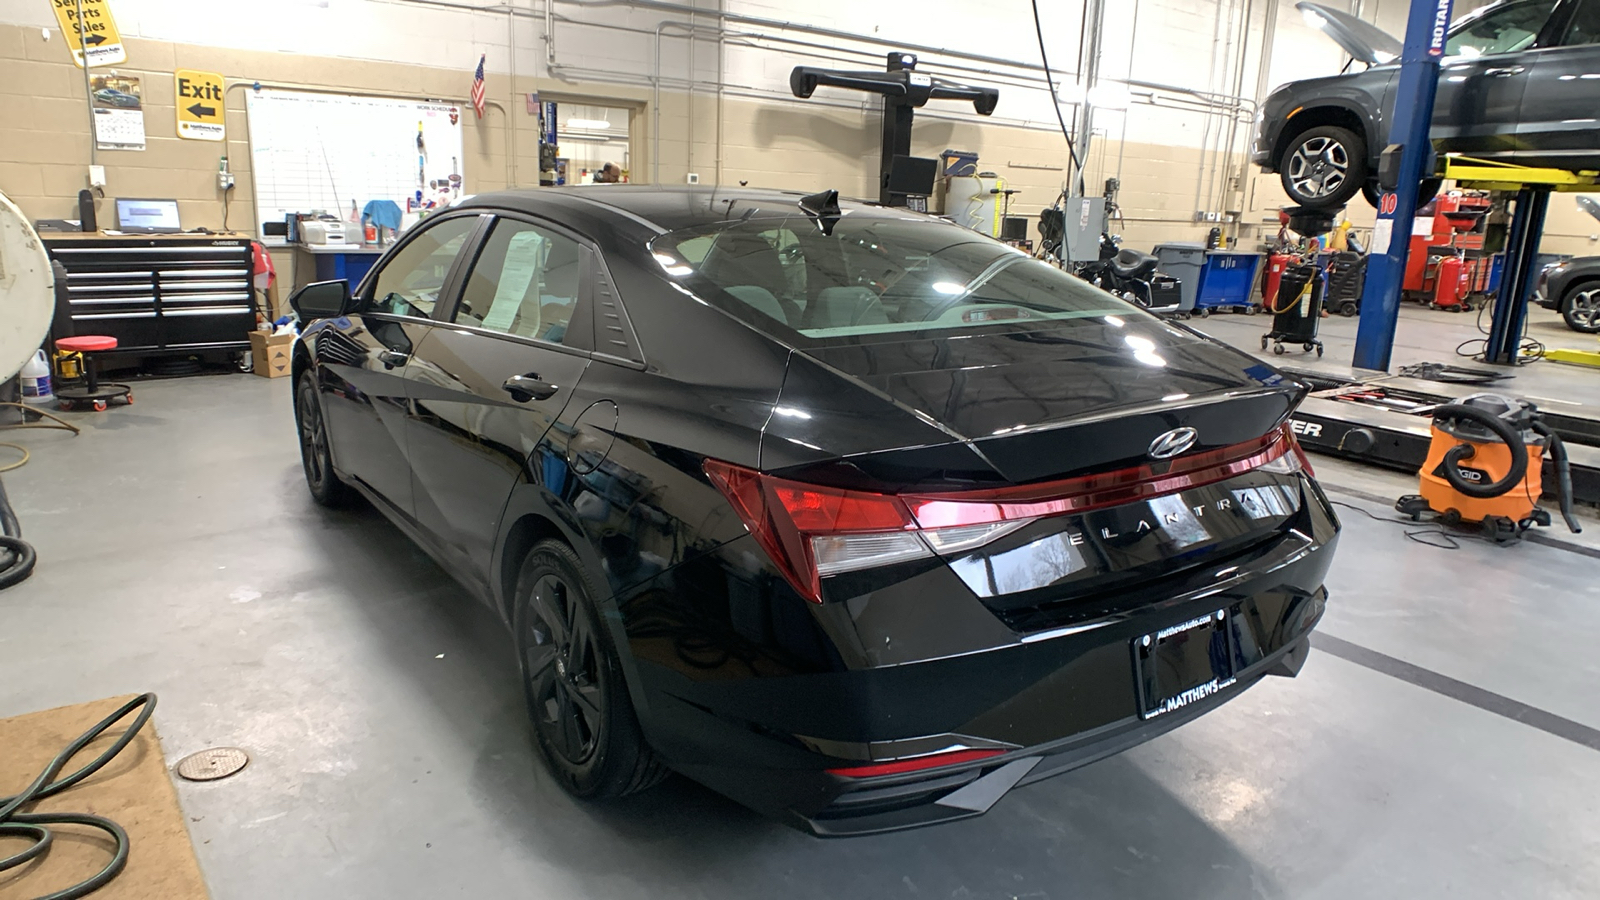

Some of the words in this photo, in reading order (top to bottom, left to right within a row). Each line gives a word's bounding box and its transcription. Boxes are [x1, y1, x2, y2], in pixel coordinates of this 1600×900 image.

[66, 8, 100, 20] Parts
[72, 21, 105, 34] Sales
[178, 78, 222, 101] Exit
[1381, 192, 1398, 215] 10
[1288, 418, 1322, 437] ER
[1066, 493, 1253, 546] ELANTRA
[1157, 615, 1211, 640] MatthewsAuto.com
[1167, 678, 1218, 713] MATTHEWS
